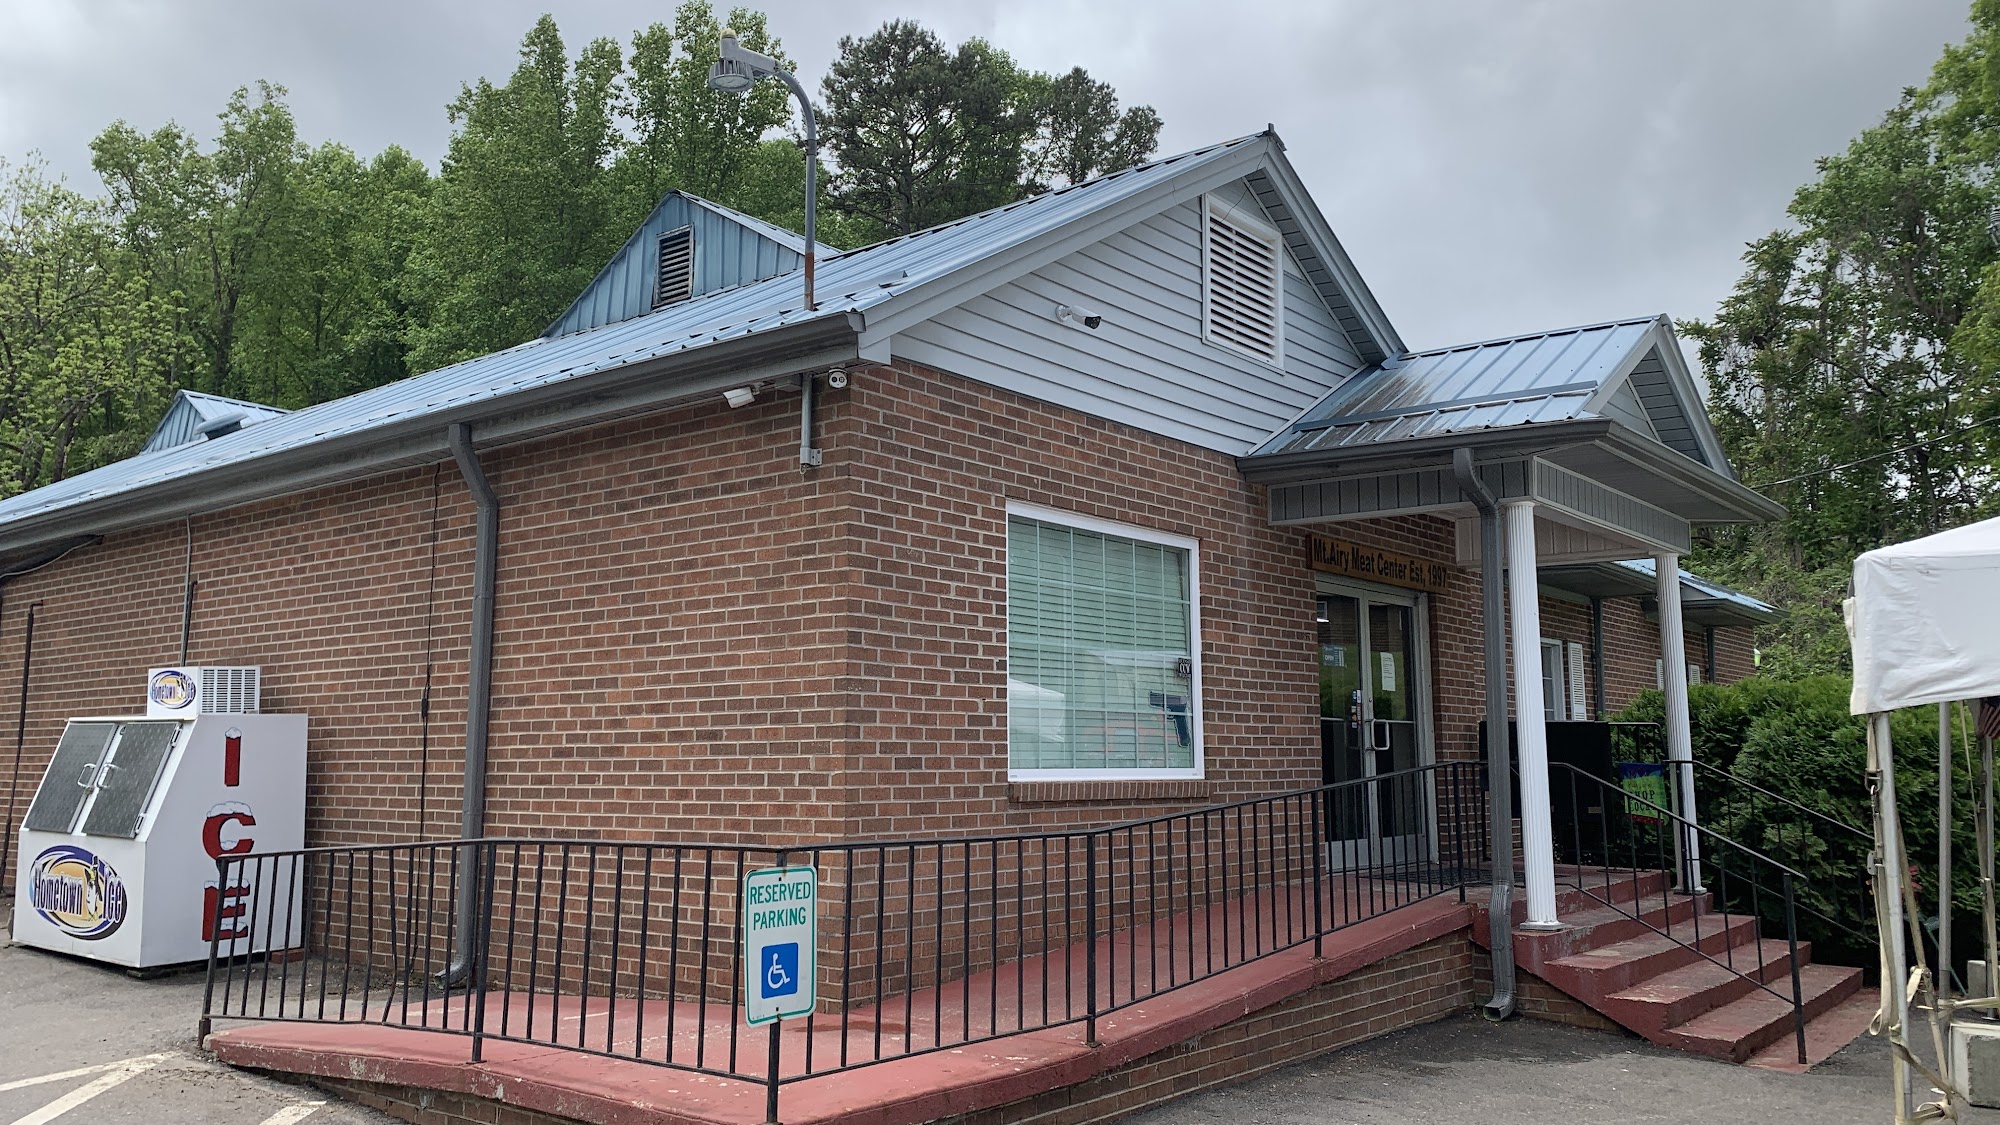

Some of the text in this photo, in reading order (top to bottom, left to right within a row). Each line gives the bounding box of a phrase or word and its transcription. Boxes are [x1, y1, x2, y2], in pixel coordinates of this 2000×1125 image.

[1314, 537, 1349, 573] Mt.Airy
[1352, 546, 1375, 575] Meat
[1377, 552, 1408, 581] Center
[1428, 564, 1448, 589] 1997
[151, 679, 196, 701] Hometown Ice
[1629, 789, 1655, 801] HOP
[1630, 800, 1656, 812] LOC
[202, 727, 256, 942] ICE
[33, 863, 123, 922] Hometown Ice
[749, 881, 811, 905] RESERVED
[753, 906, 807, 931] PARKING
